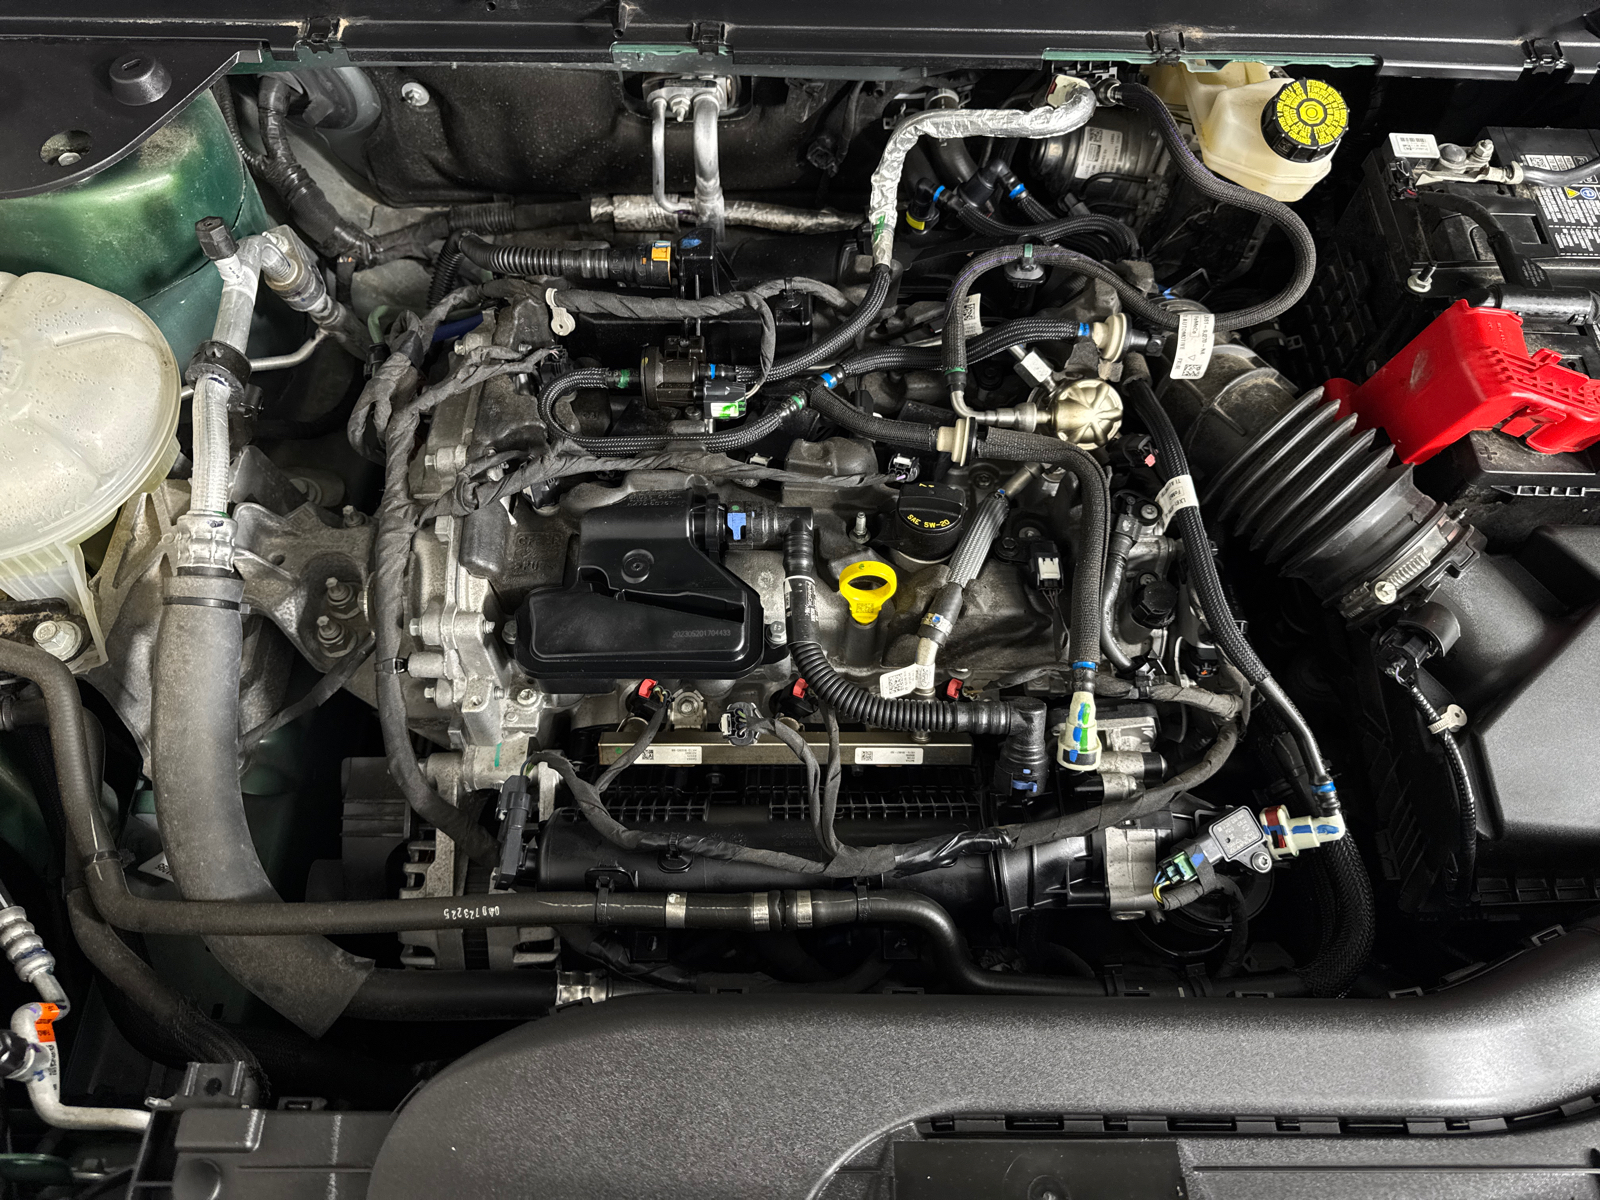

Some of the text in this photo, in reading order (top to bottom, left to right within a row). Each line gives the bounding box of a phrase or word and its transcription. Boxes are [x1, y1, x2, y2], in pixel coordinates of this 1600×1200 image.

[1180, 319, 1188, 350] AUTOMOTIVE
[907, 514, 950, 528] SAE 5W-20
